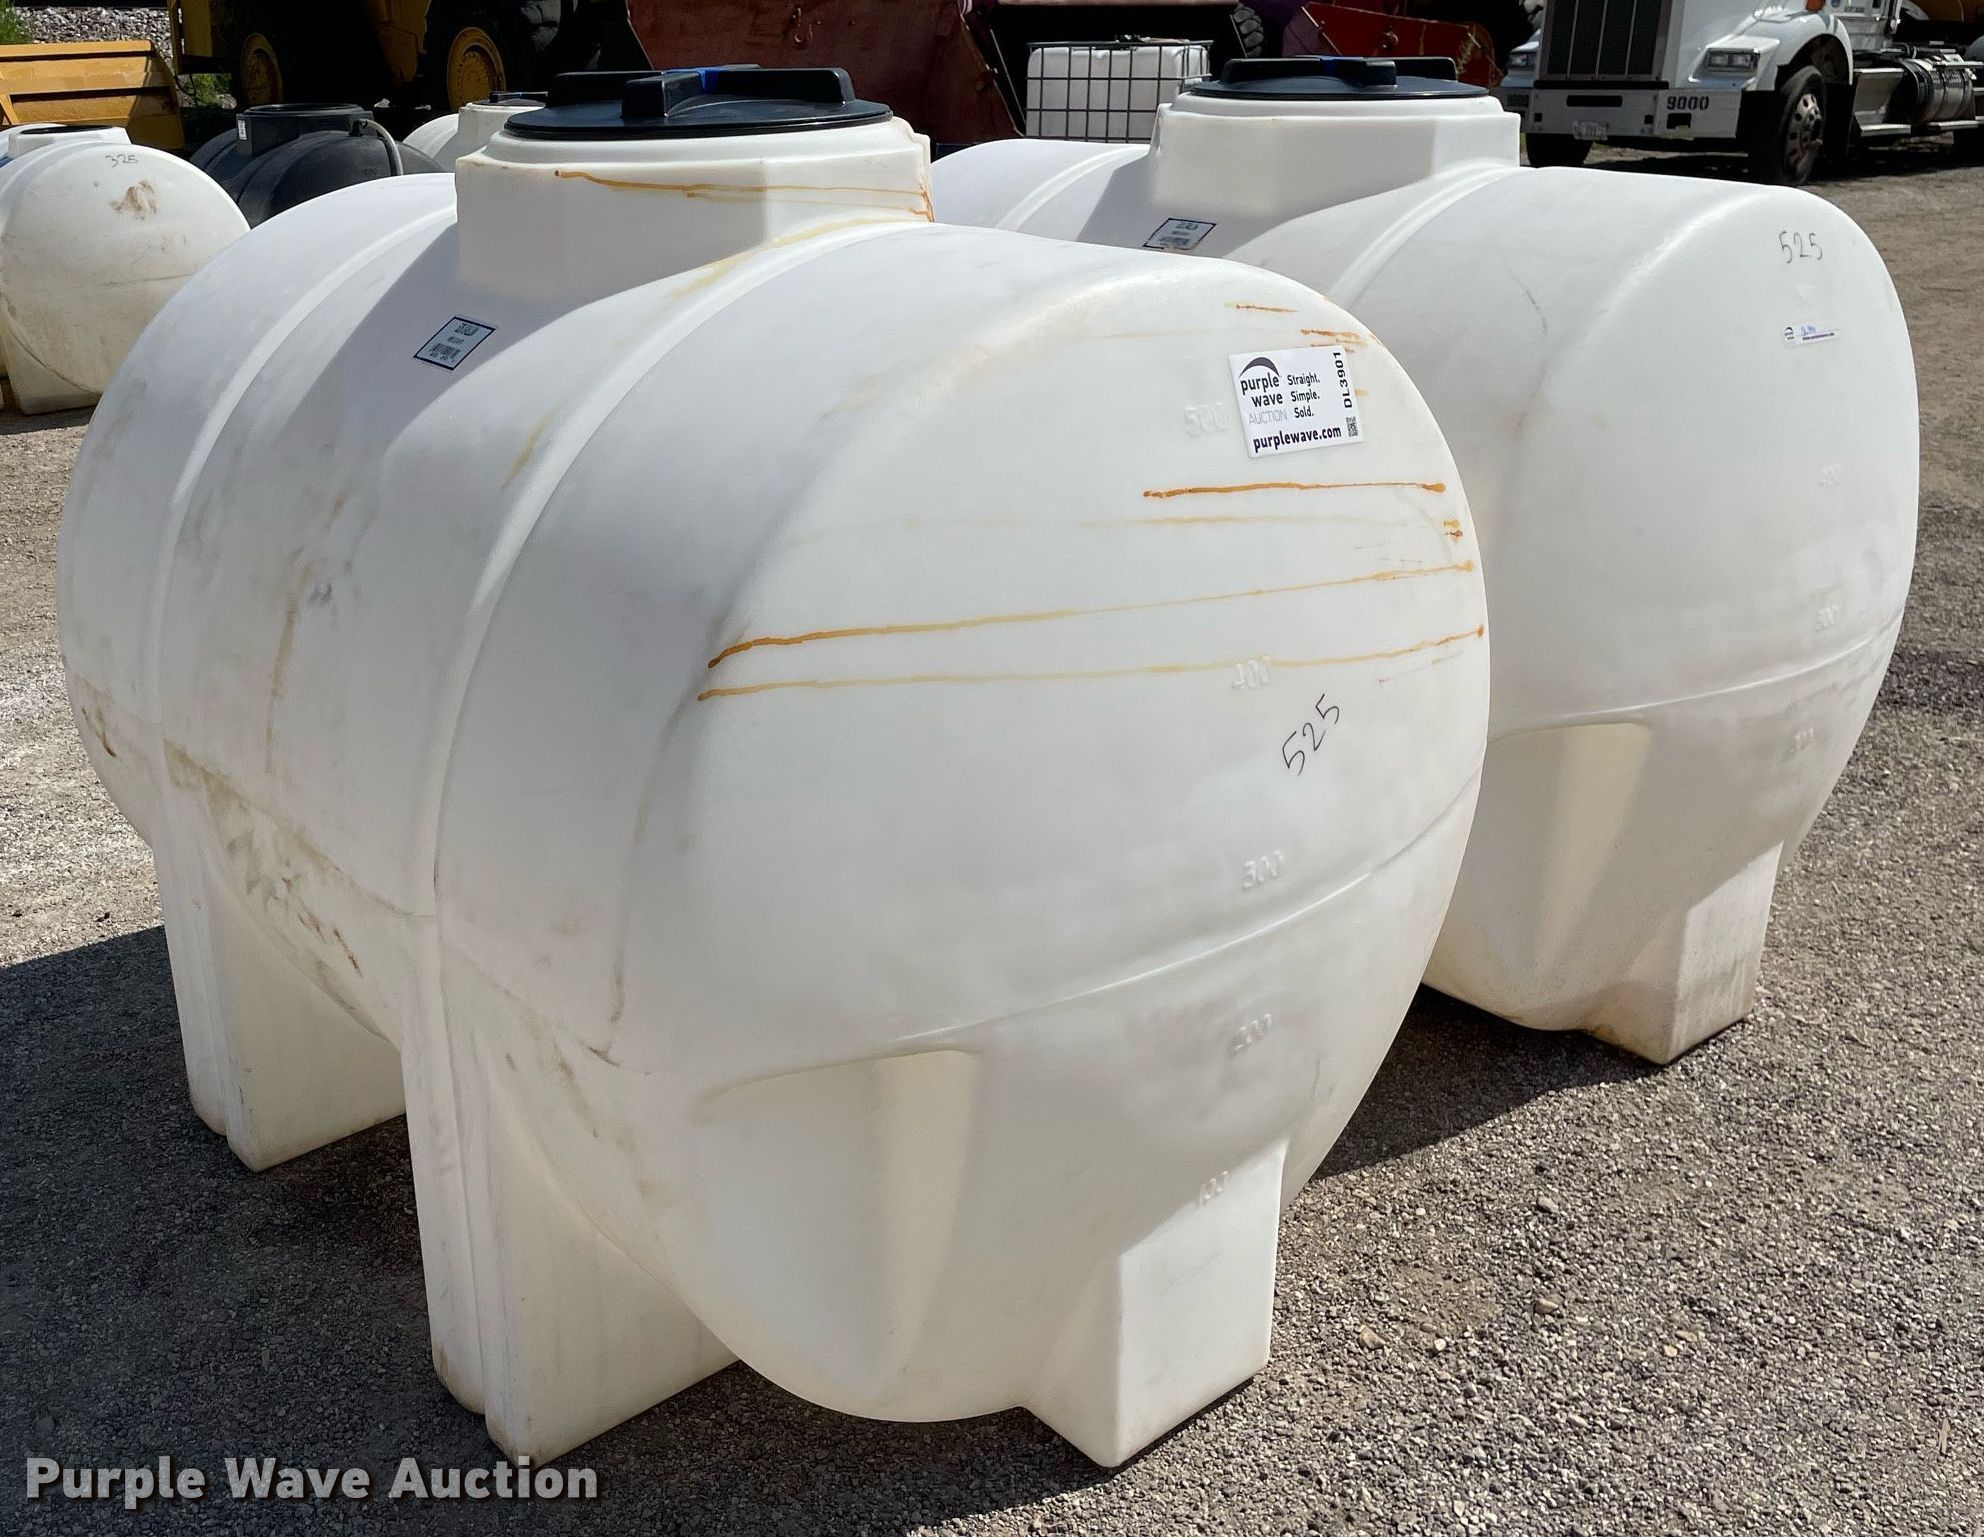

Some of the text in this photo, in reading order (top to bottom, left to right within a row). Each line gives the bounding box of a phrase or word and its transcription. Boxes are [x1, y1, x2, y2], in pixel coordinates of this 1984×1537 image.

[1666, 96, 1710, 111] 9000
[104, 153, 139, 168] 325
[1778, 230, 1823, 264] 525
[1240, 372, 1280, 396] purple
[1287, 372, 1321, 387] Straight.
[1332, 351, 1353, 409] DL3901
[1251, 393, 1283, 408] wave
[1290, 388, 1321, 404] Simple.
[1184, 401, 1229, 439] 500
[1248, 409, 1288, 425] AUCTION
[1293, 406, 1315, 419] Sold.
[1252, 425, 1343, 453] purplewave.com
[1281, 692, 1340, 777] 525
